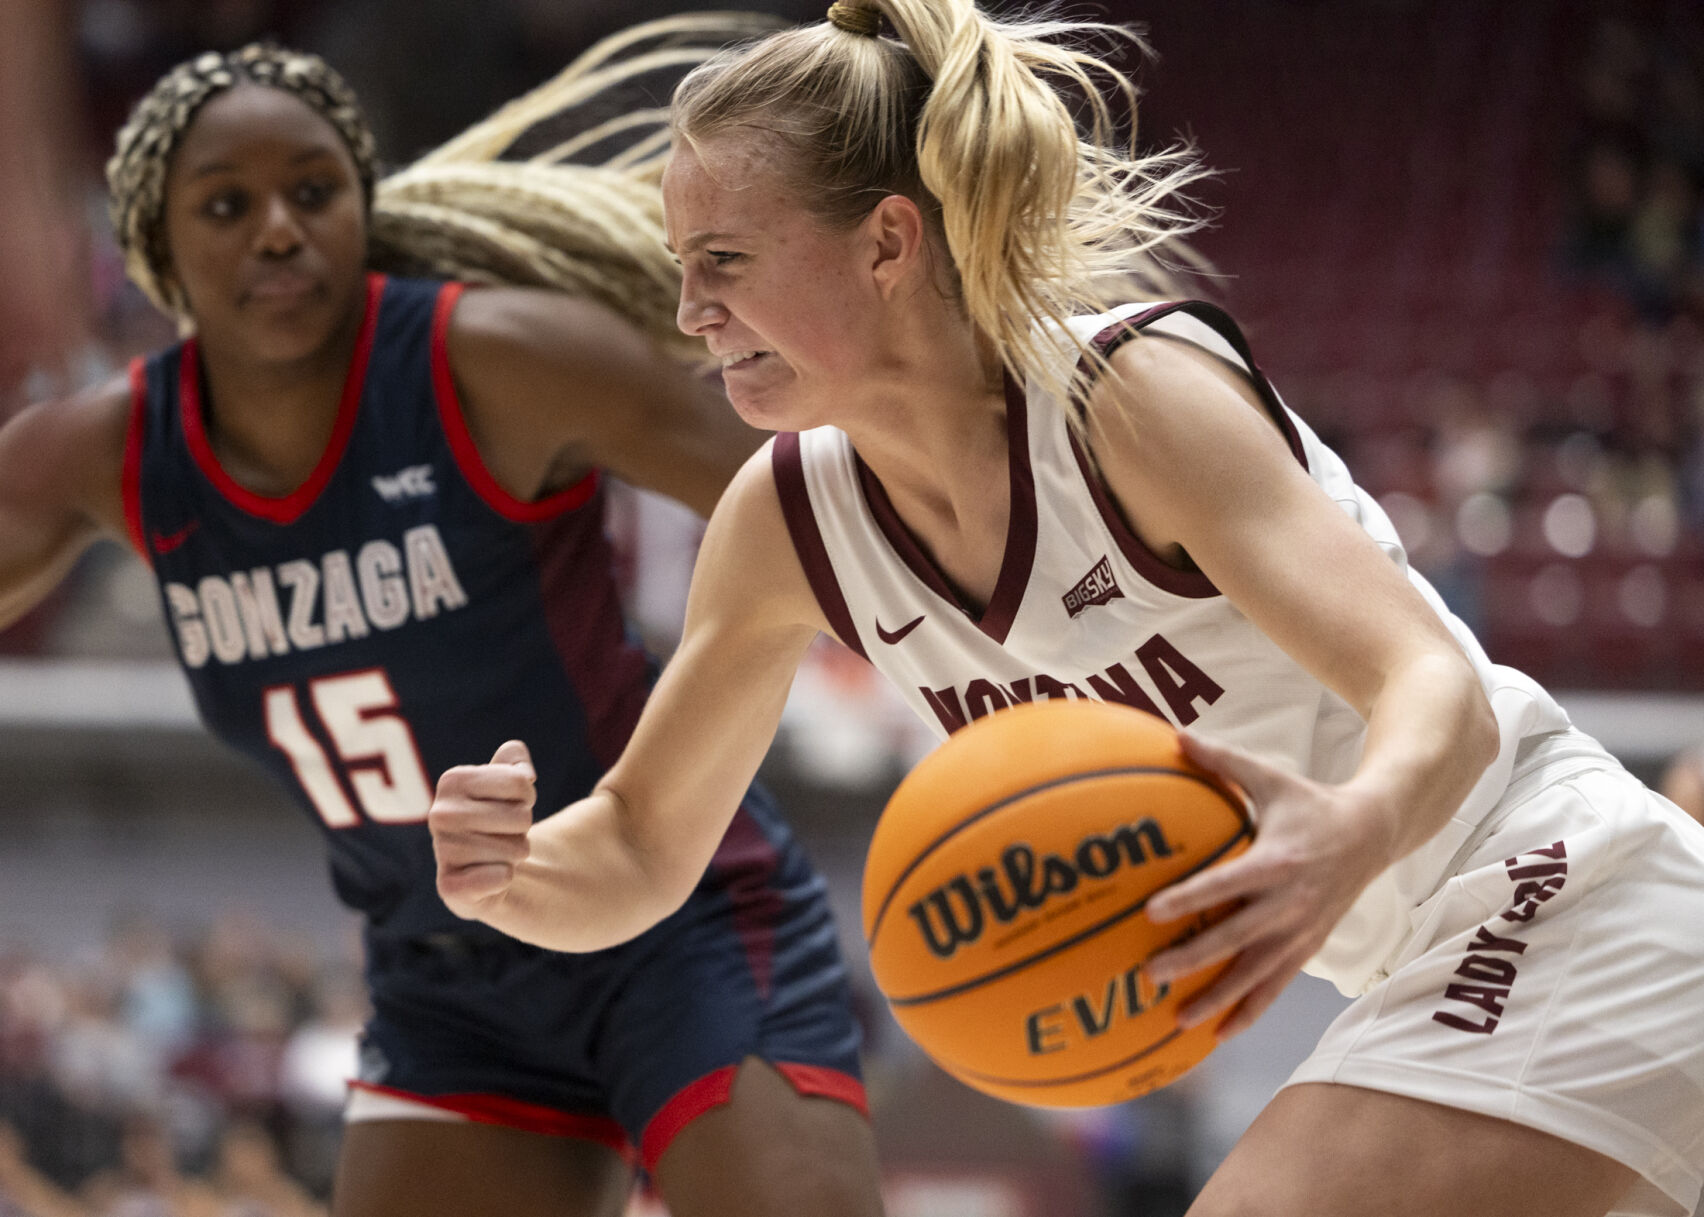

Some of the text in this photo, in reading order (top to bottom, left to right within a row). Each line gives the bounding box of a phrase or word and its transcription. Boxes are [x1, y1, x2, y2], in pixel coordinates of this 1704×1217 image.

[166, 524, 467, 668] GONZAGA
[263, 666, 434, 829] 15
[907, 816, 1173, 960] Wilson
[1432, 925, 1528, 1035] LADY
